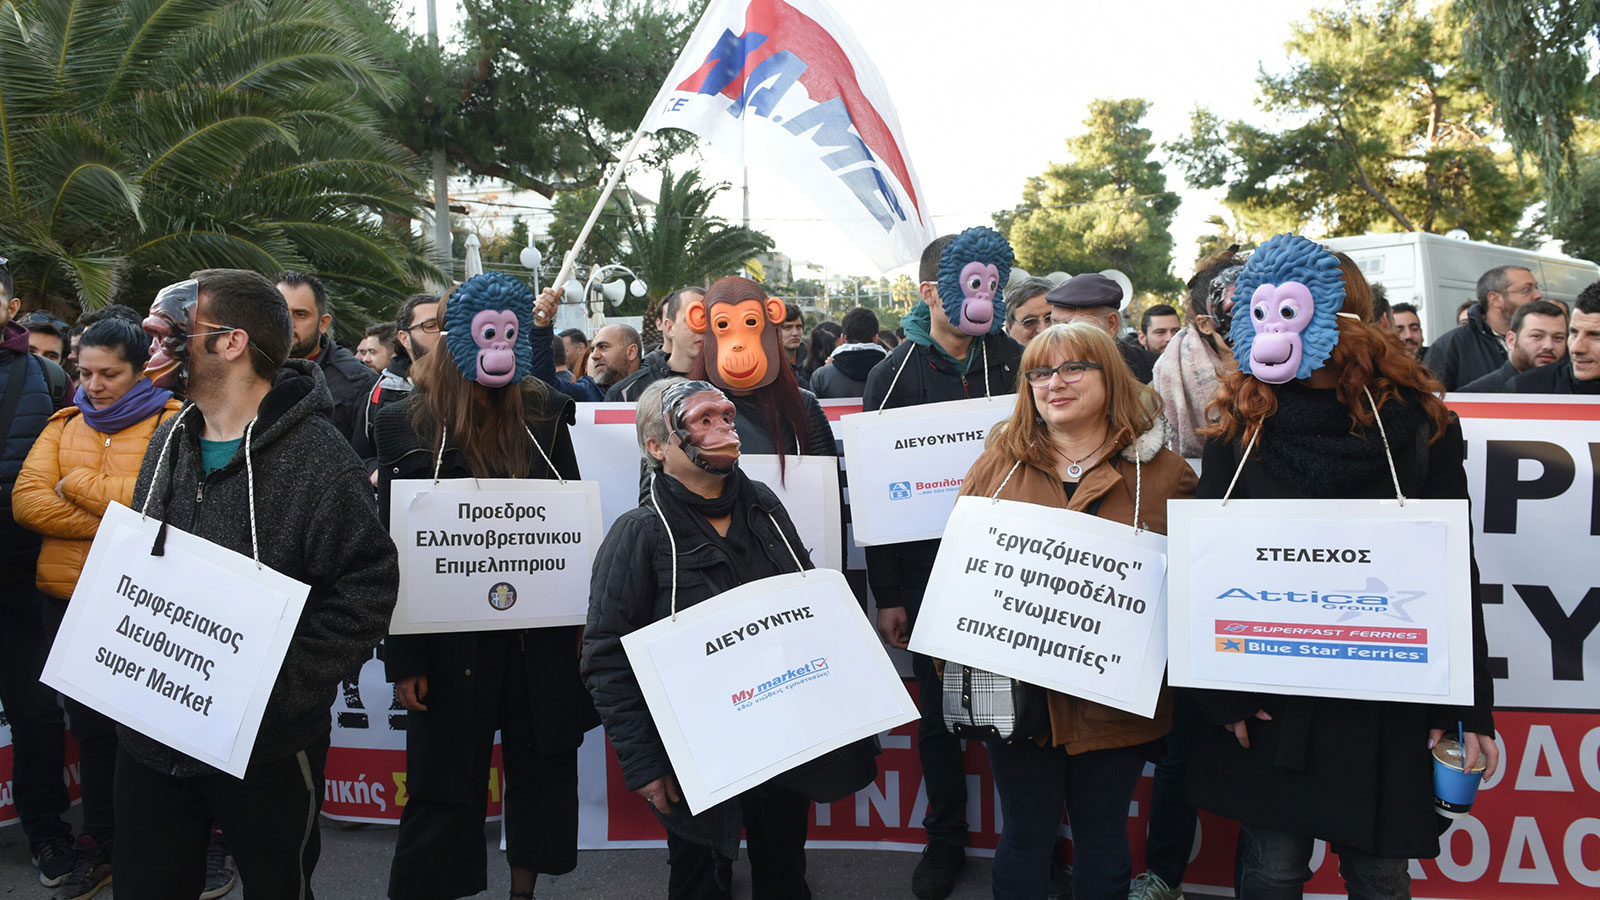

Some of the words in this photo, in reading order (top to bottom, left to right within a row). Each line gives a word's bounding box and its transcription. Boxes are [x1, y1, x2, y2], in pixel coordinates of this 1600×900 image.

[894, 430, 984, 449] ΔΙΕΥΘΥΝΤΗΣ
[458, 503, 546, 522] Προεδρος
[416, 530, 582, 549] Ελληνοβρετανικου
[988, 527, 1143, 580] "εργαζόμενος"
[1256, 547, 1371, 564] ΣΤΕΛΕΧΟΣ
[435, 557, 566, 577] Επιμελητηριου
[965, 557, 989, 574] με
[994, 562, 1015, 579] το
[1020, 568, 1147, 615] ψηφοδέλτιο
[116, 574, 244, 654] Περιφερειακος
[993, 589, 1102, 636] "ενωμενοι
[1215, 588, 1388, 605] Attica
[1321, 604, 1388, 613] Group
[115, 614, 216, 682] Διευθυντης
[705, 606, 814, 656] ΔΙΕΥΘΥΝΤΗΣ
[956, 616, 1122, 675] επιχειρηματίες"
[1252, 625, 1344, 637] SUPERFAST
[1349, 631, 1418, 640] FERRIES
[1248, 642, 1292, 654] Blue
[1299, 644, 1340, 656] Star
[1347, 647, 1420, 660] Ferries
[95, 646, 145, 682] super
[145, 668, 213, 717] Market
[731, 688, 755, 704] My
[757, 663, 811, 692] market
[324, 774, 386, 812] τικής
